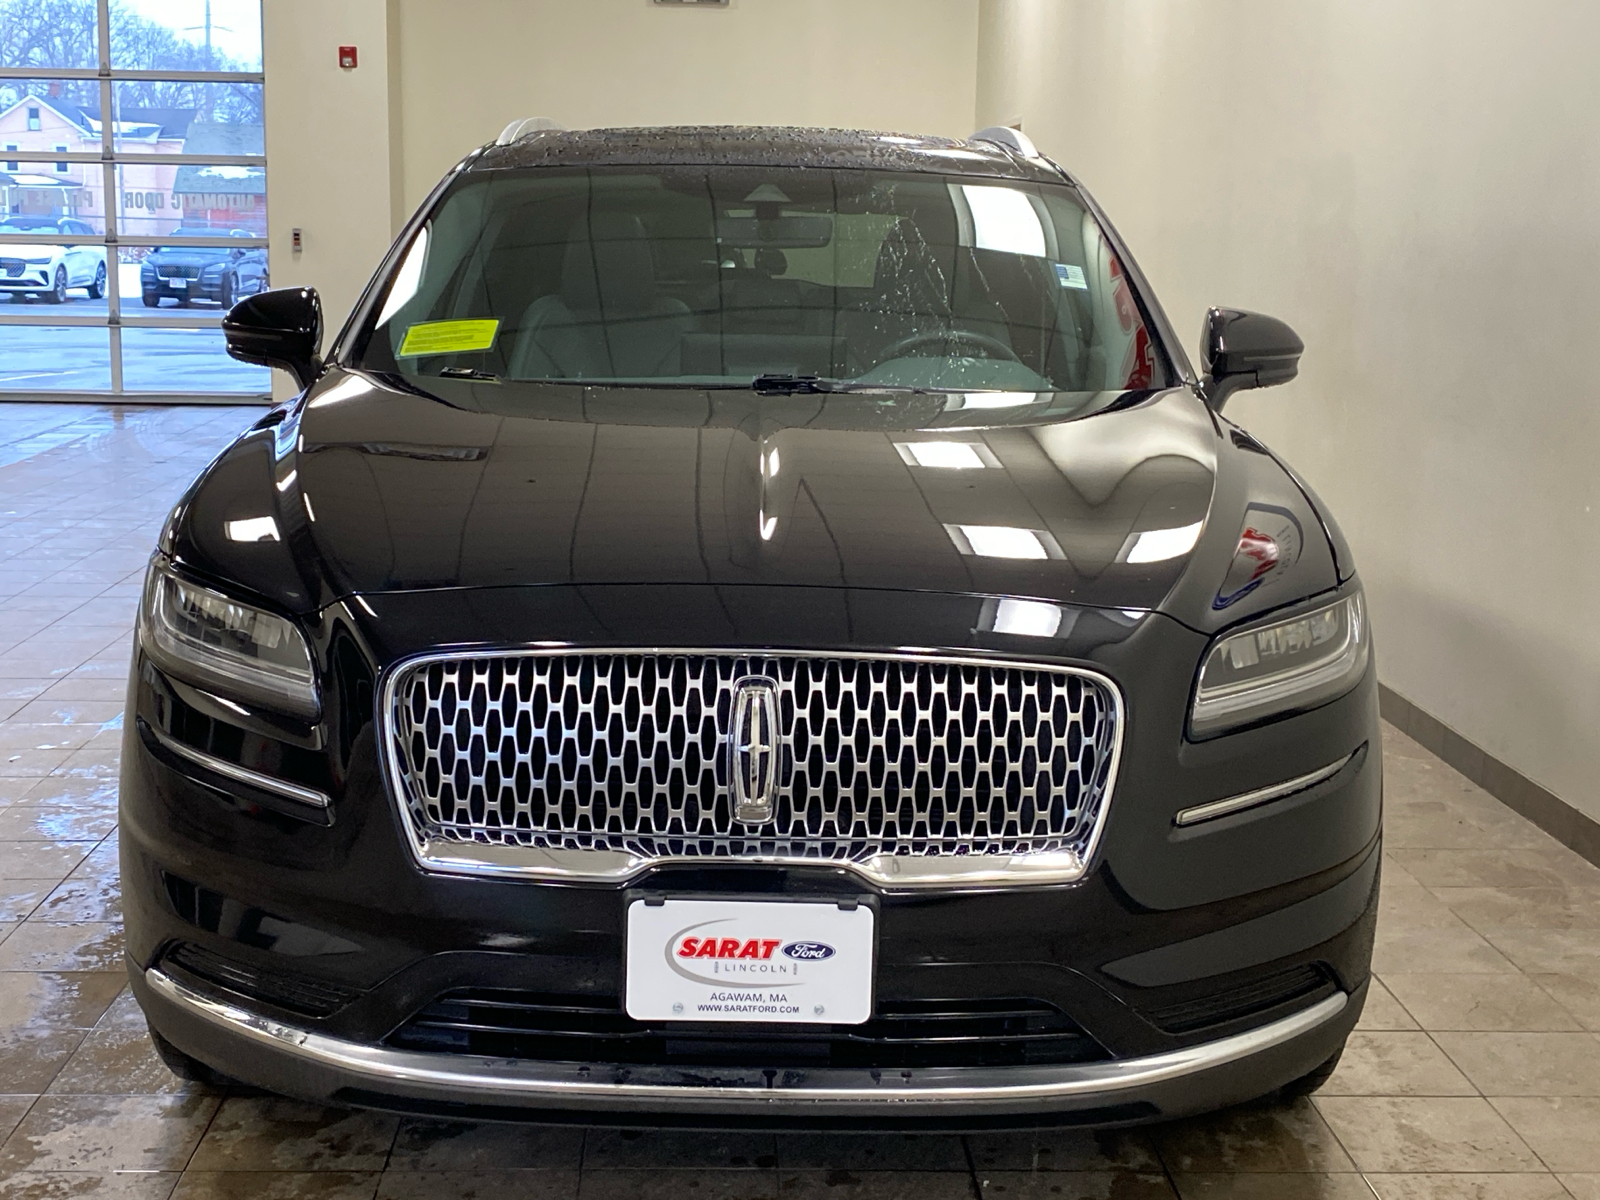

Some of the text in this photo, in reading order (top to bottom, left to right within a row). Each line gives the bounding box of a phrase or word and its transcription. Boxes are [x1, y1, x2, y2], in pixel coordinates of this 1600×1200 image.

[677, 936, 827, 960] SARAT Ford
[724, 963, 788, 974] LINCOLN
[709, 992, 788, 1004] AGAWAM, MA
[697, 1004, 800, 1014] WWW.SARATFORD.COM
